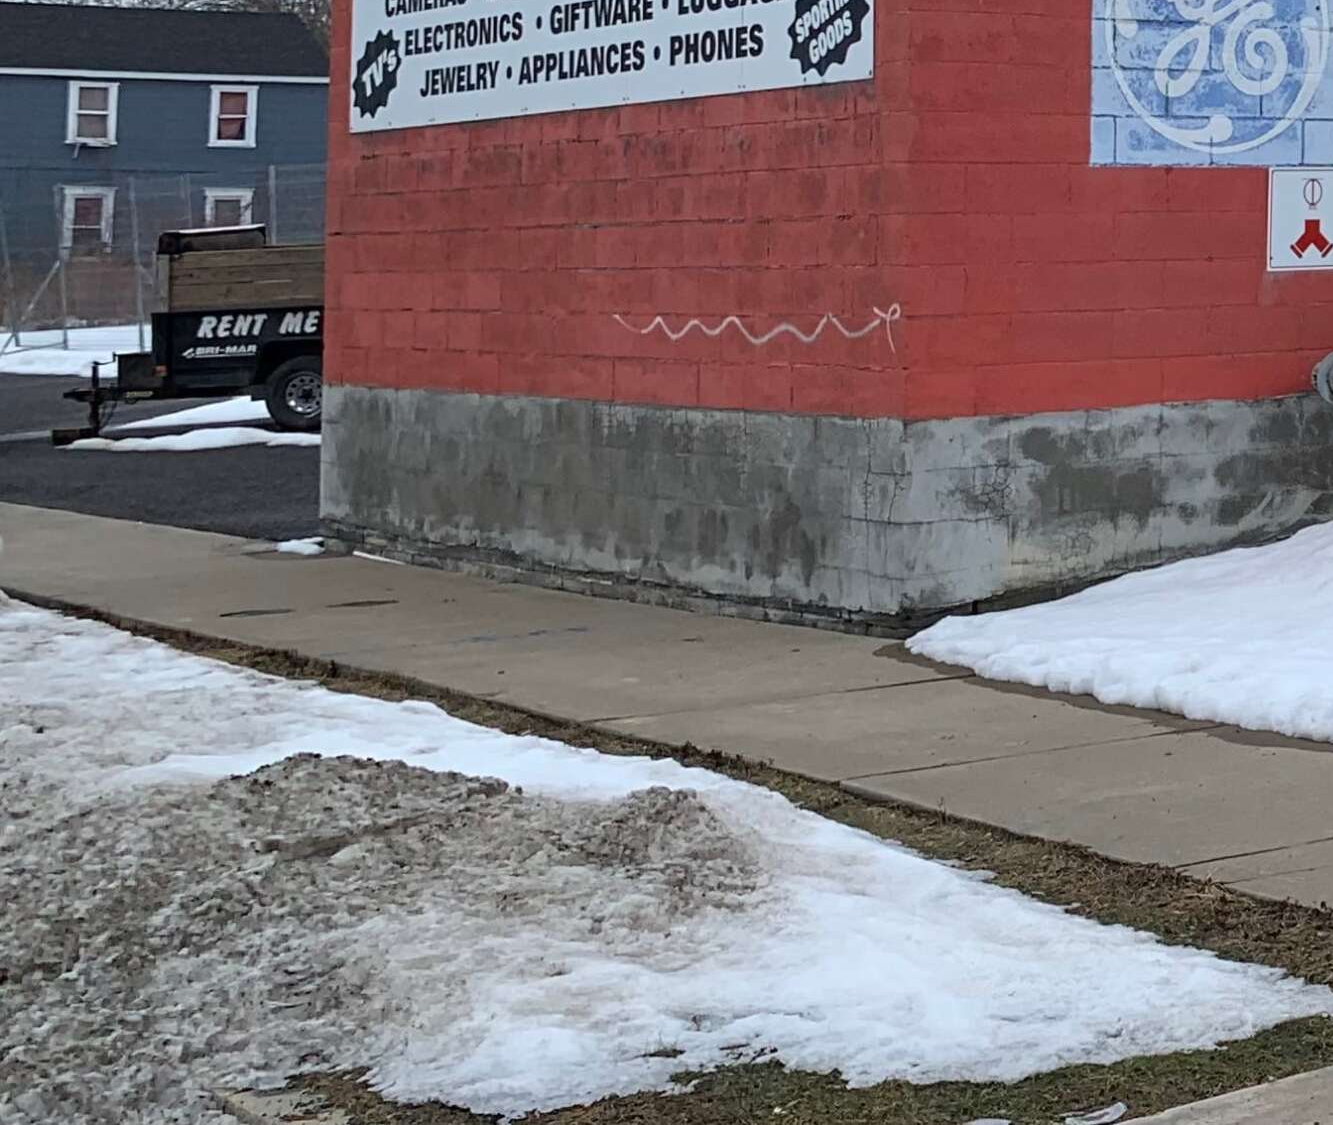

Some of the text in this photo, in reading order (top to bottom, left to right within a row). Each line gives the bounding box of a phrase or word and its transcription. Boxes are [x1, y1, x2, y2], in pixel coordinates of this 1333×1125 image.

[404, 11, 524, 57] ELECTRONICS
[808, 10, 854, 65] GOODS
[419, 23, 764, 98] JEWELRY APPLIANCES PHONES
[196, 310, 321, 339] RENT ME
[195, 344, 258, 356] BRI-MAR
